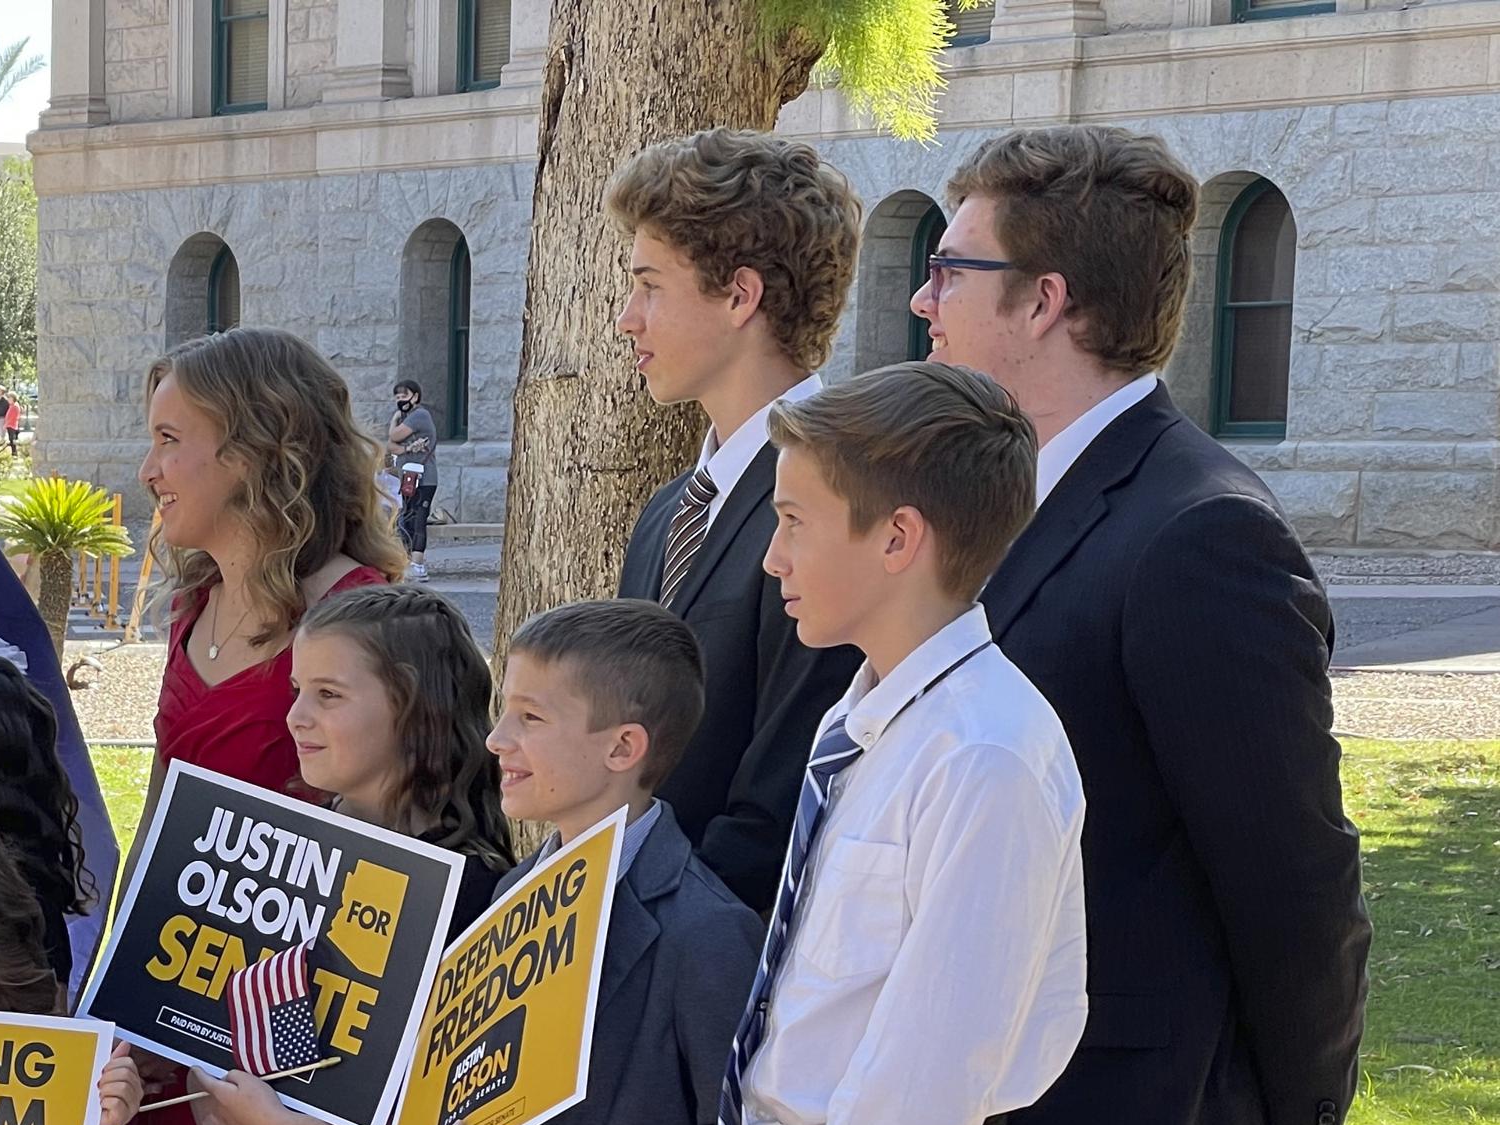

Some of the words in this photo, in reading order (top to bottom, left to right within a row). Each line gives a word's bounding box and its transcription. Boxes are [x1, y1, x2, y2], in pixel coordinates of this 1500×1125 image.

[193, 806, 342, 898] JUSTIN
[177, 860, 326, 950] OLSON
[346, 900, 392, 937] FOR
[435, 858, 588, 1017] DEFENDING
[145, 914, 380, 1055] SENTE
[422, 912, 577, 1079] FREEDOM
[170, 1015, 187, 1027] PAID
[186, 1021, 201, 1034] FOR
[200, 1027, 211, 1037] BY
[452, 1041, 486, 1084] JUSTIN
[447, 1042, 512, 1113] OLSON
[475, 1075, 507, 1100] SENATE
